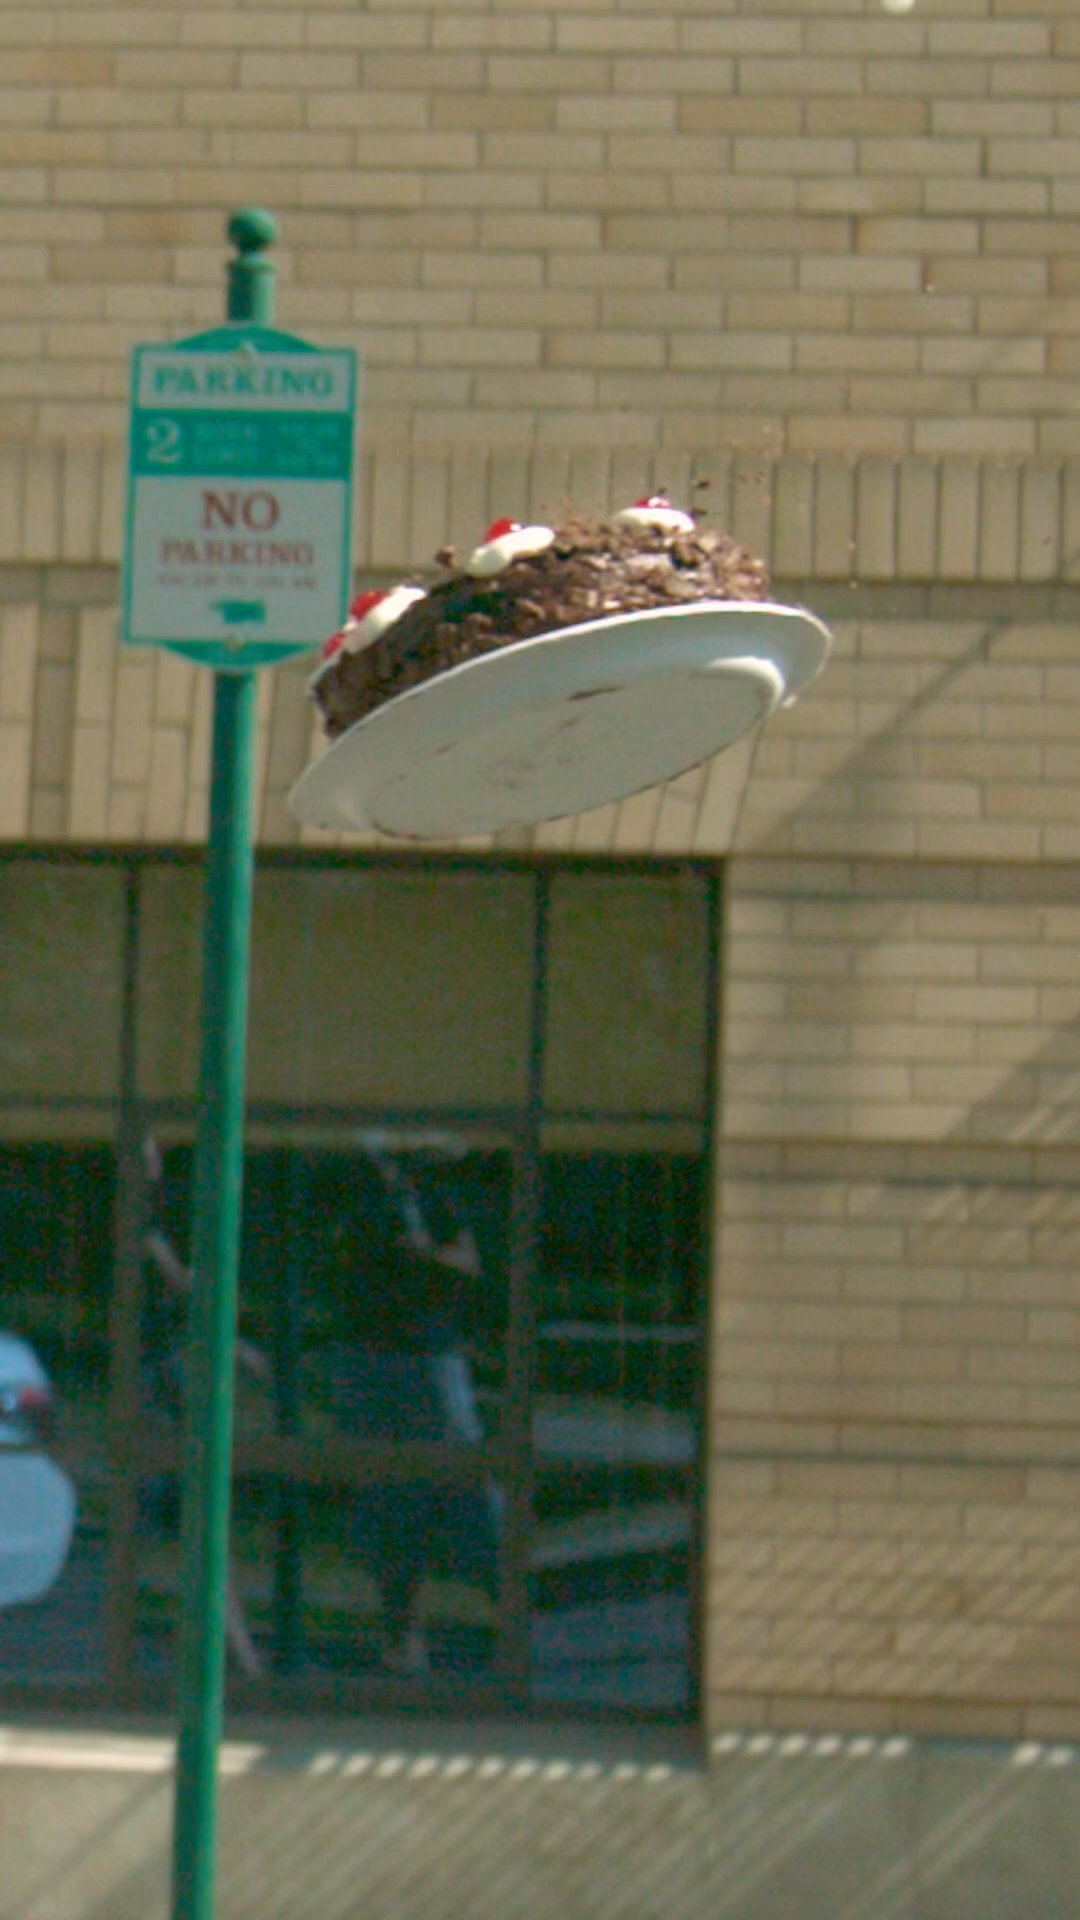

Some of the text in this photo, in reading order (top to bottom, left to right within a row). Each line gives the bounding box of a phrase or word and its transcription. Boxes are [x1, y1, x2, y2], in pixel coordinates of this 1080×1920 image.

[154, 367, 333, 396] PARKING
[146, 417, 181, 464] 2
[203, 488, 280, 532] NO
[161, 540, 315, 567] PARKING
